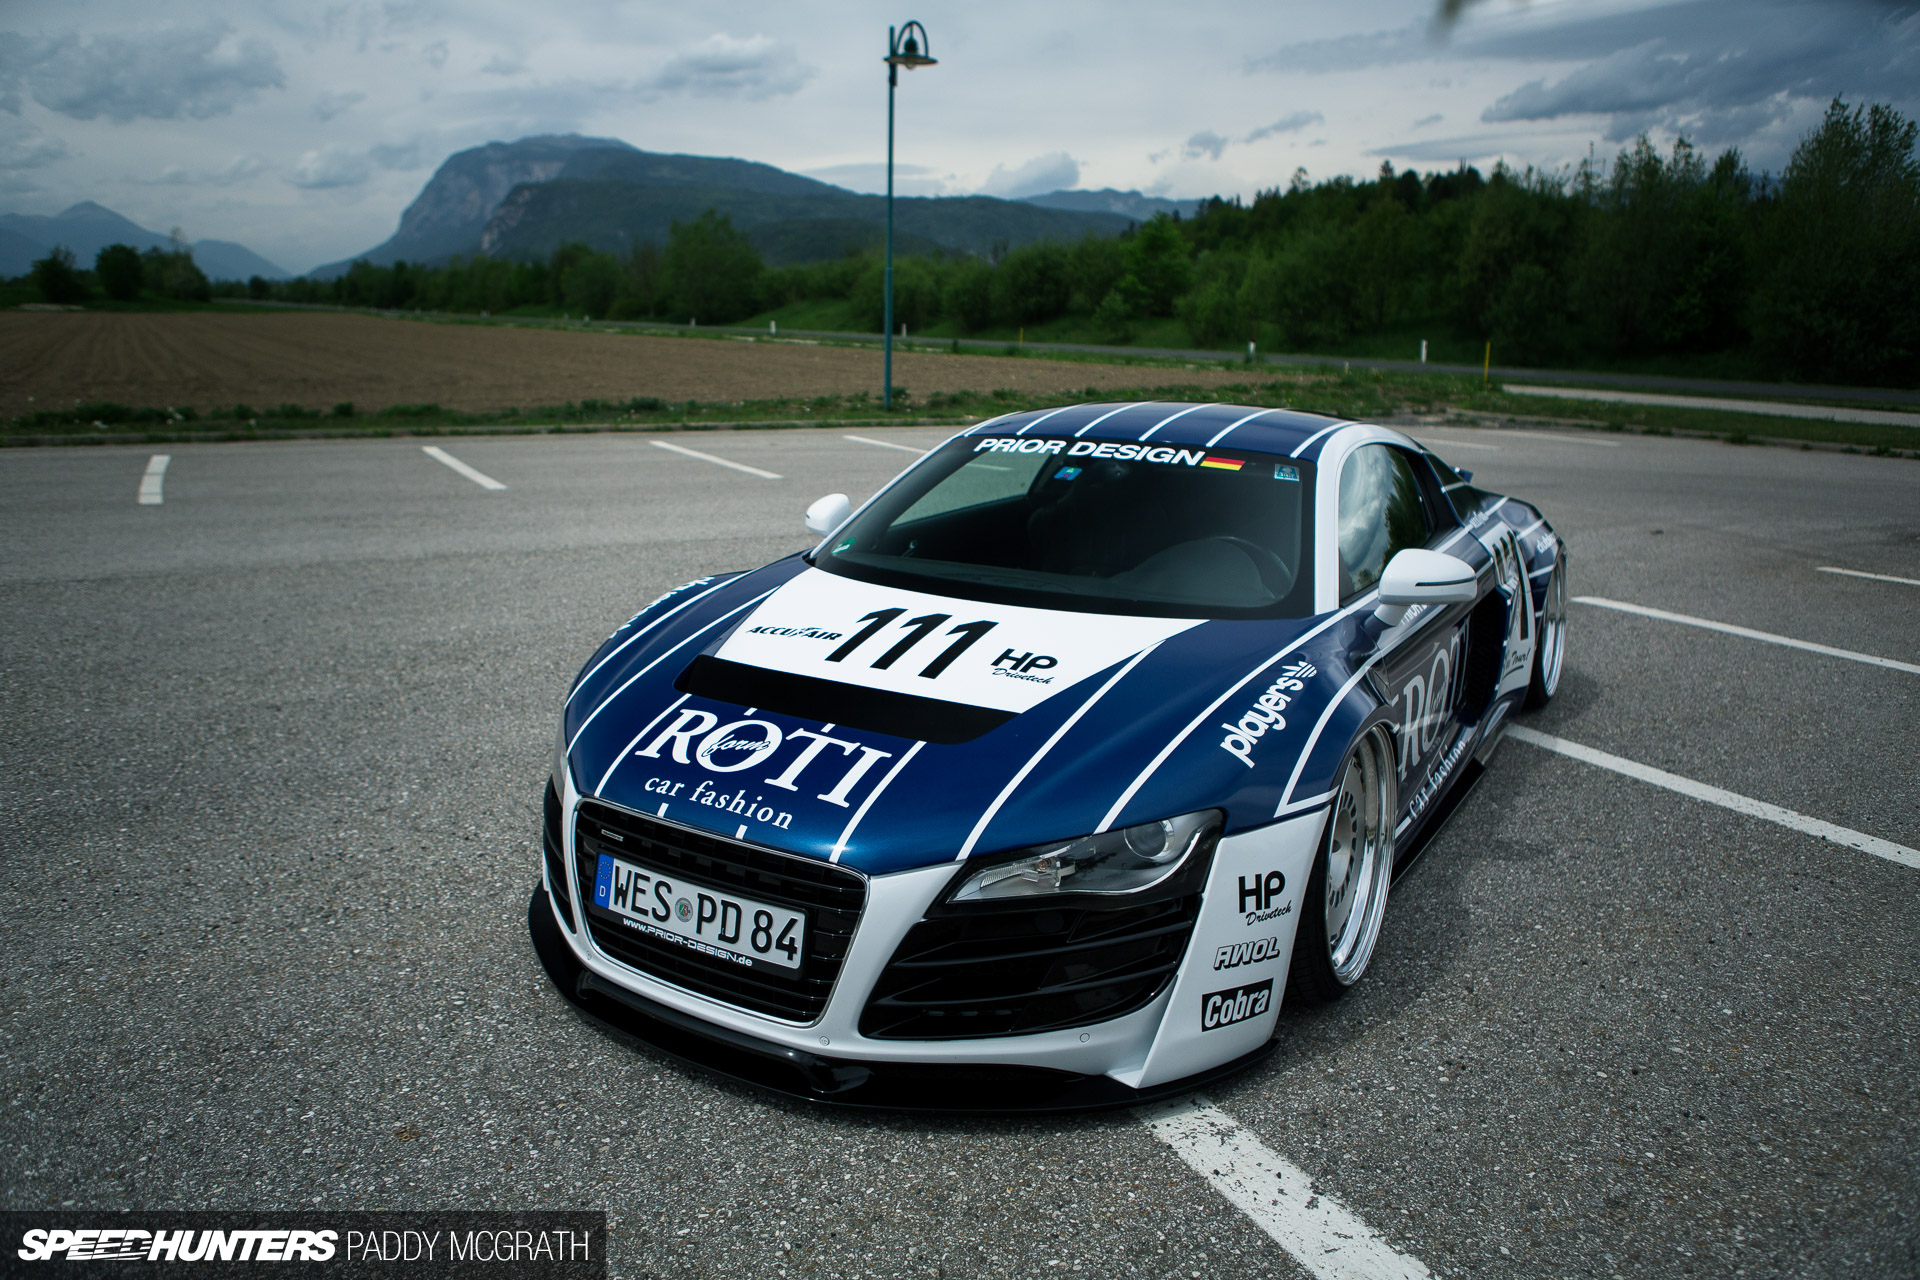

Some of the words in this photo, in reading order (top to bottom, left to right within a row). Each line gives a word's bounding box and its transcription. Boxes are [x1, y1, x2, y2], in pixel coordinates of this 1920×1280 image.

[973, 438, 1066, 455] PRIOR
[1068, 441, 1206, 466] DESIGN
[824, 607, 999, 679] 111
[990, 648, 1058, 673] HP
[992, 668, 1055, 684] Drivetech
[1220, 677, 1304, 769] players
[635, 708, 892, 808] ROTI
[645, 777, 685, 797] car
[688, 780, 794, 830] fashion
[599, 885, 606, 897] D
[1238, 870, 1286, 914] HP
[613, 865, 672, 922] WES
[696, 893, 742, 945] PD
[751, 909, 798, 961] 84
[1245, 900, 1292, 926] Drivetech
[623, 918, 753, 967] www.PRIOR-DESIGN.de
[1213, 937, 1280, 971] AWOL
[1204, 988, 1270, 1028] Cobra
